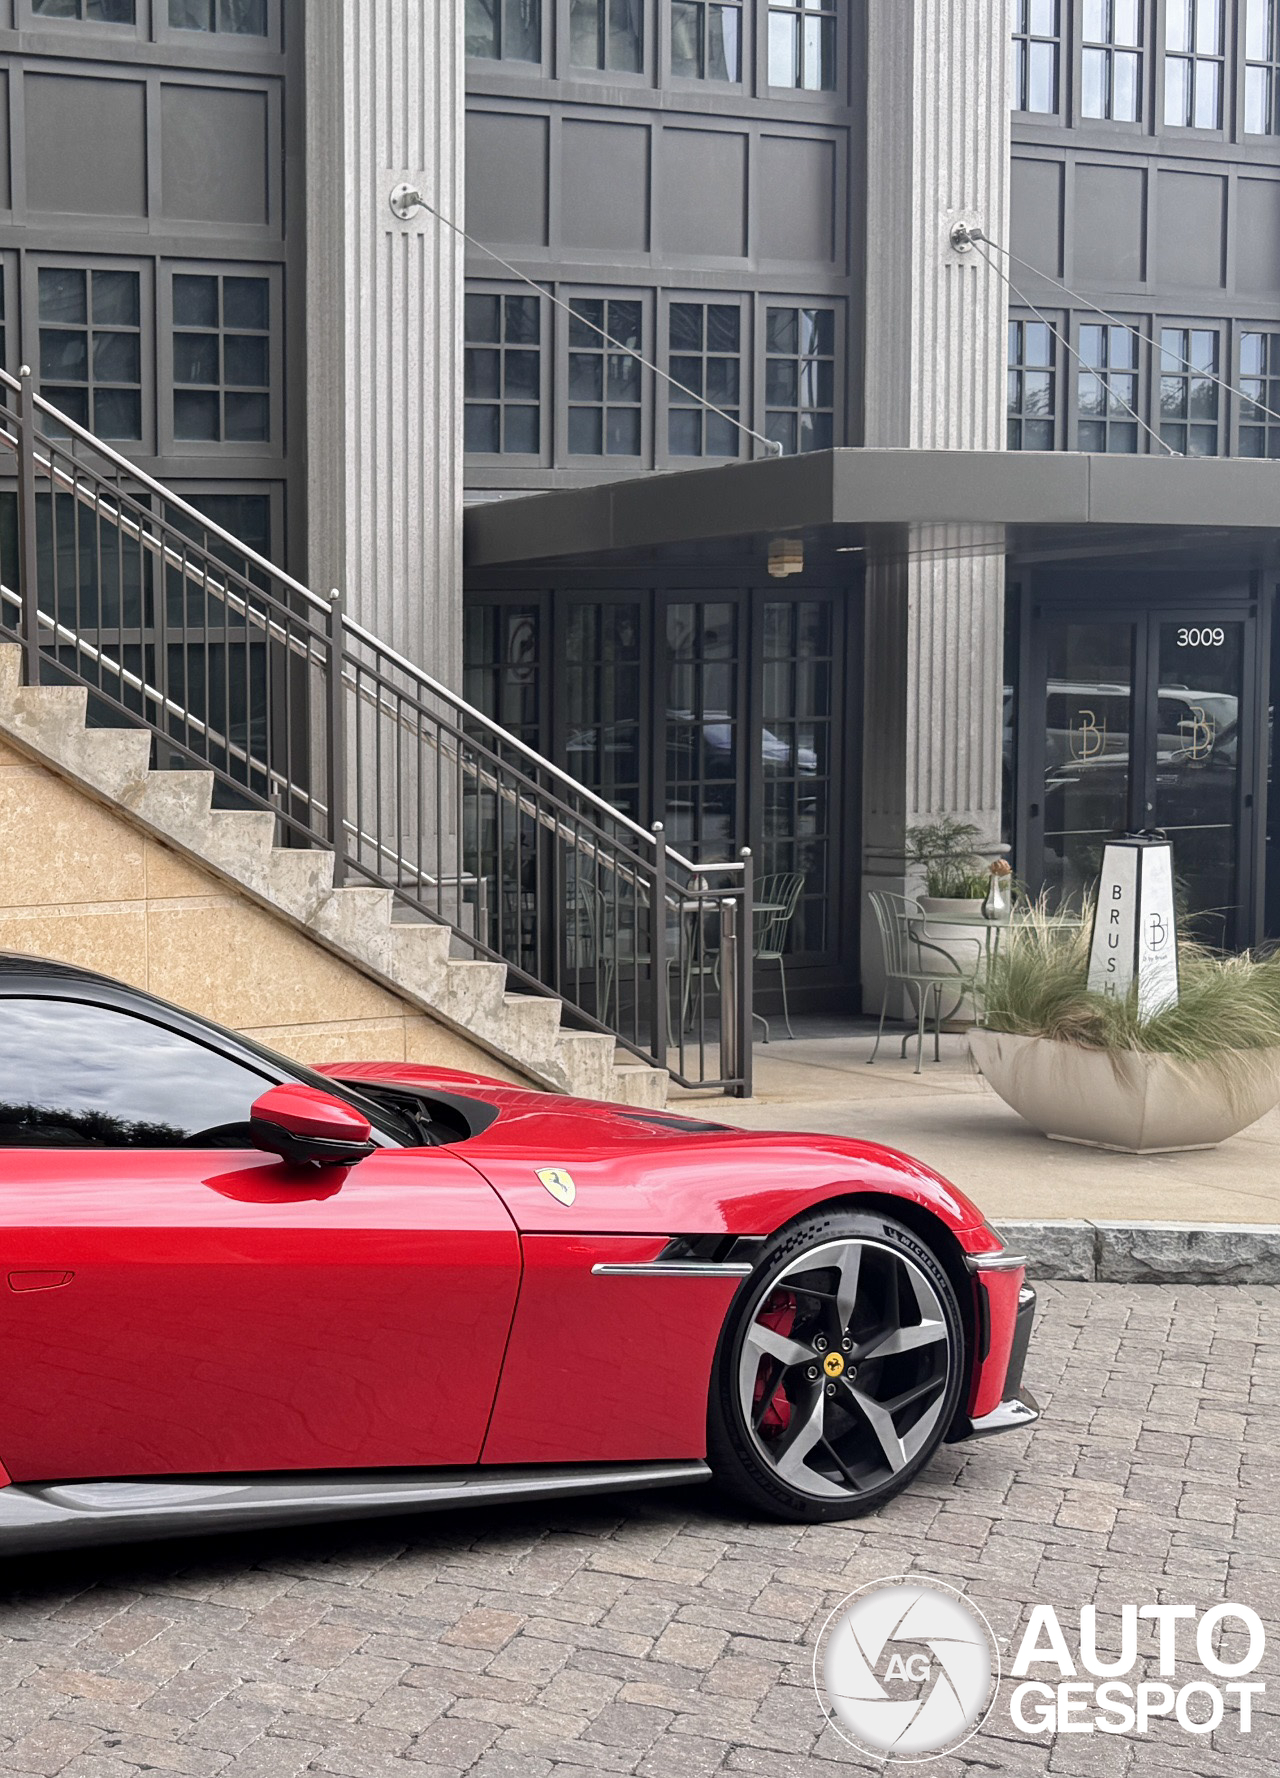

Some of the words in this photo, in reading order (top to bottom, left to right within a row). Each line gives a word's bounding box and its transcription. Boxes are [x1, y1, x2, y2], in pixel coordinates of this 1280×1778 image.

[1177, 627, 1225, 647] 3009
[1104, 884, 1123, 997] BRUSH
[900, 1236, 947, 1288] MICHELIN
